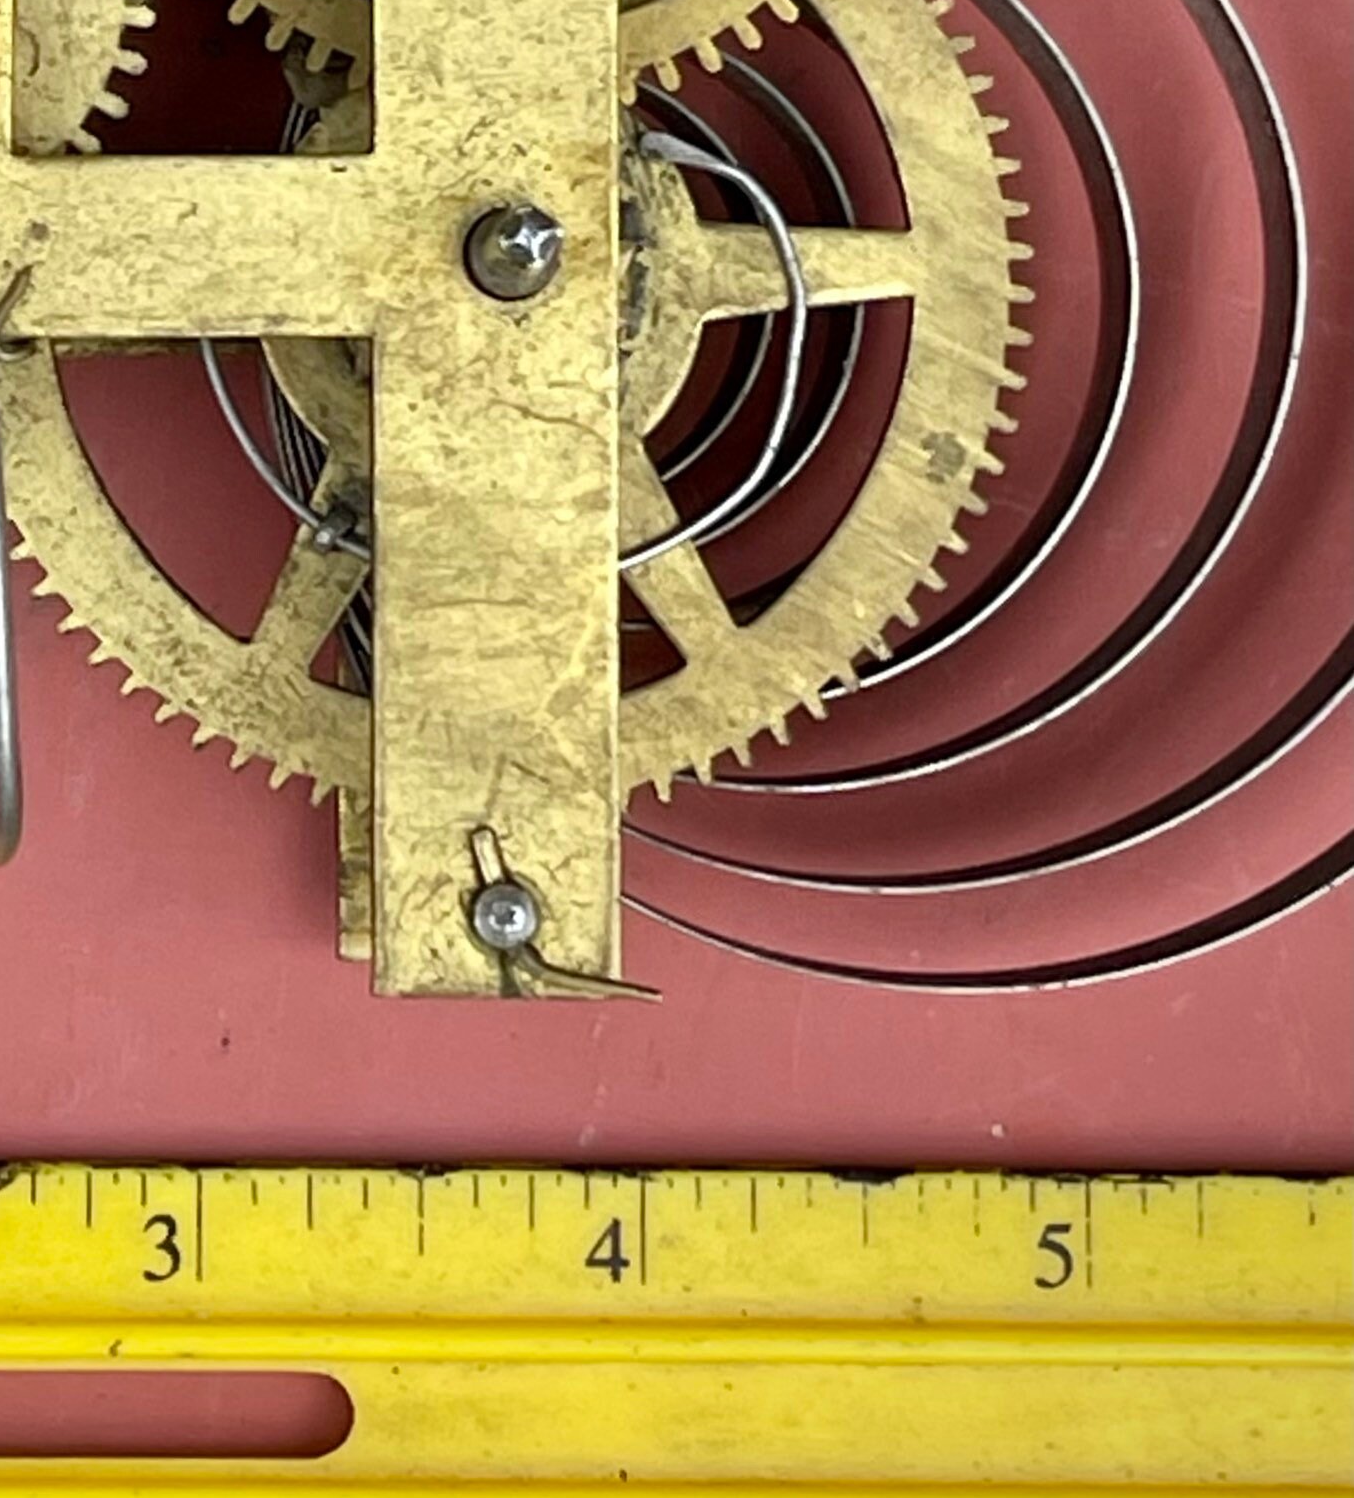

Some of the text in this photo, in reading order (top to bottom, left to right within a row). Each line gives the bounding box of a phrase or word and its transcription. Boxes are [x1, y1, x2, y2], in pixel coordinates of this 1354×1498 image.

[142, 1214, 182, 1282] 3
[584, 1217, 631, 1284] 4
[1034, 1223, 1074, 1289] 5
